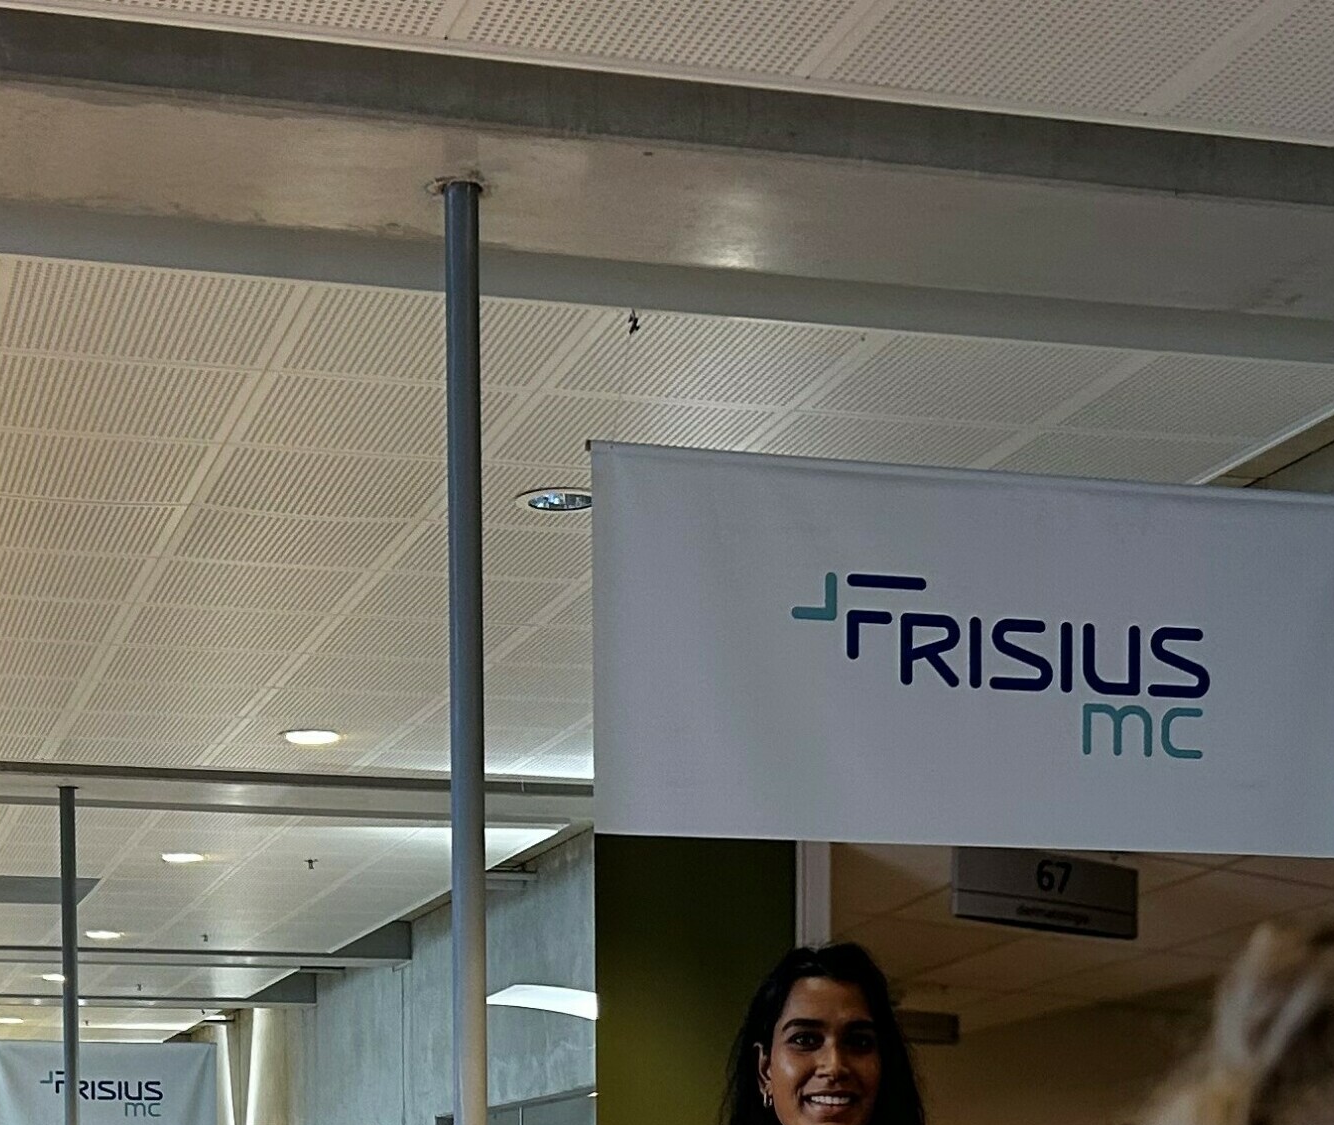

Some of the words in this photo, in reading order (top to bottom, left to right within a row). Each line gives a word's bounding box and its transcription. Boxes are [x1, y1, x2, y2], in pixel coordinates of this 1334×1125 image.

[847, 574, 1210, 698] FRISIUS
[1082, 703, 1203, 759] mc
[1037, 860, 1072, 894] 67
[125, 1102, 161, 1117] mc
